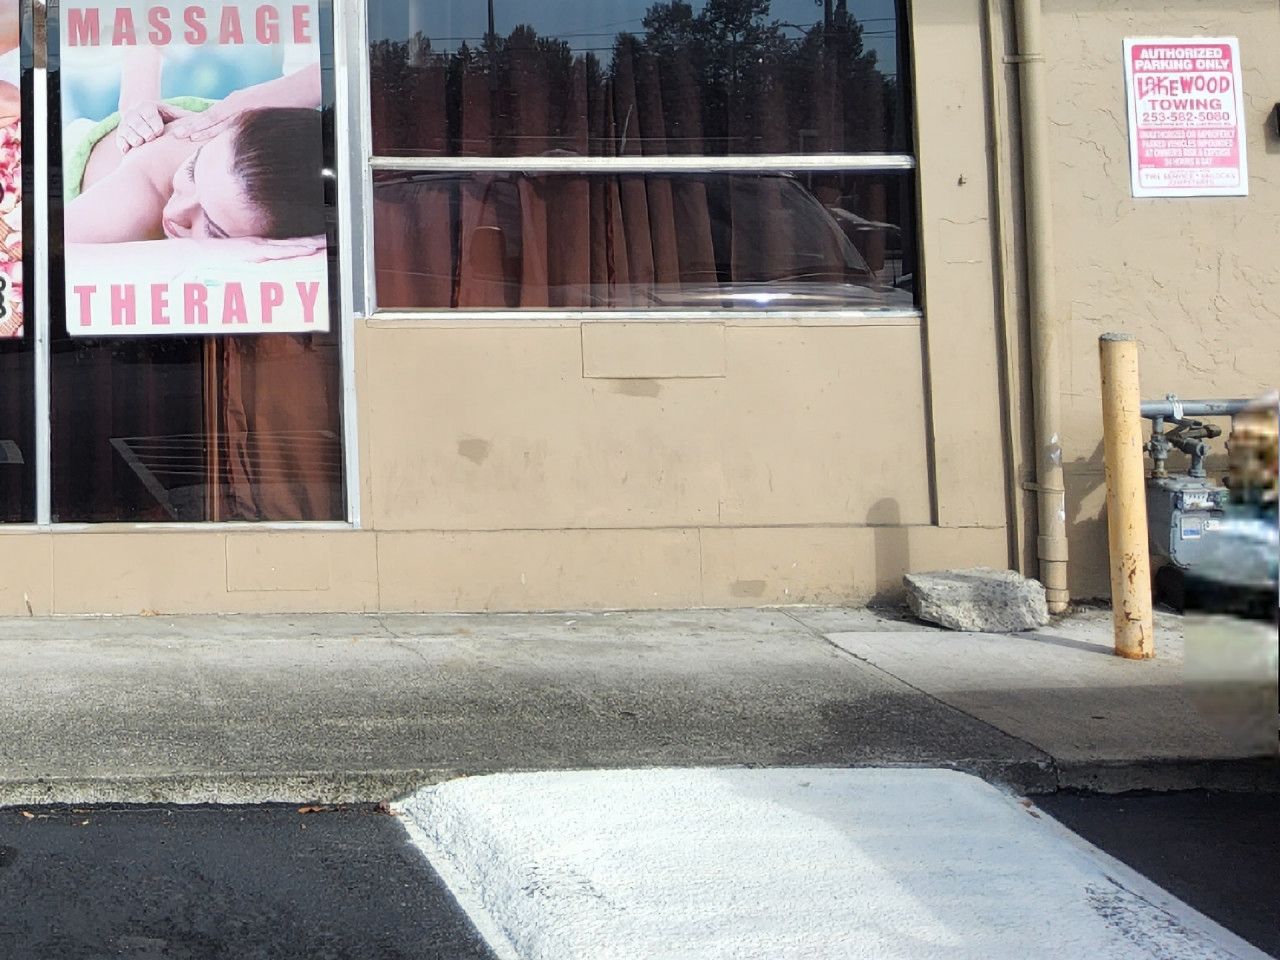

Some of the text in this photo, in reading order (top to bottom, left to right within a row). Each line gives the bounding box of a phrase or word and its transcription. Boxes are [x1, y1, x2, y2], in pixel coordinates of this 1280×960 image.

[67, 4, 313, 47] MASSAGE
[1140, 48, 1223, 59] AUTHORIZED
[1135, 59, 1230, 71] PARKING ONLY
[1137, 75, 1230, 100] LAKEWOOD
[1148, 99, 1222, 111] TOWING
[73, 281, 321, 327] THERAPY
